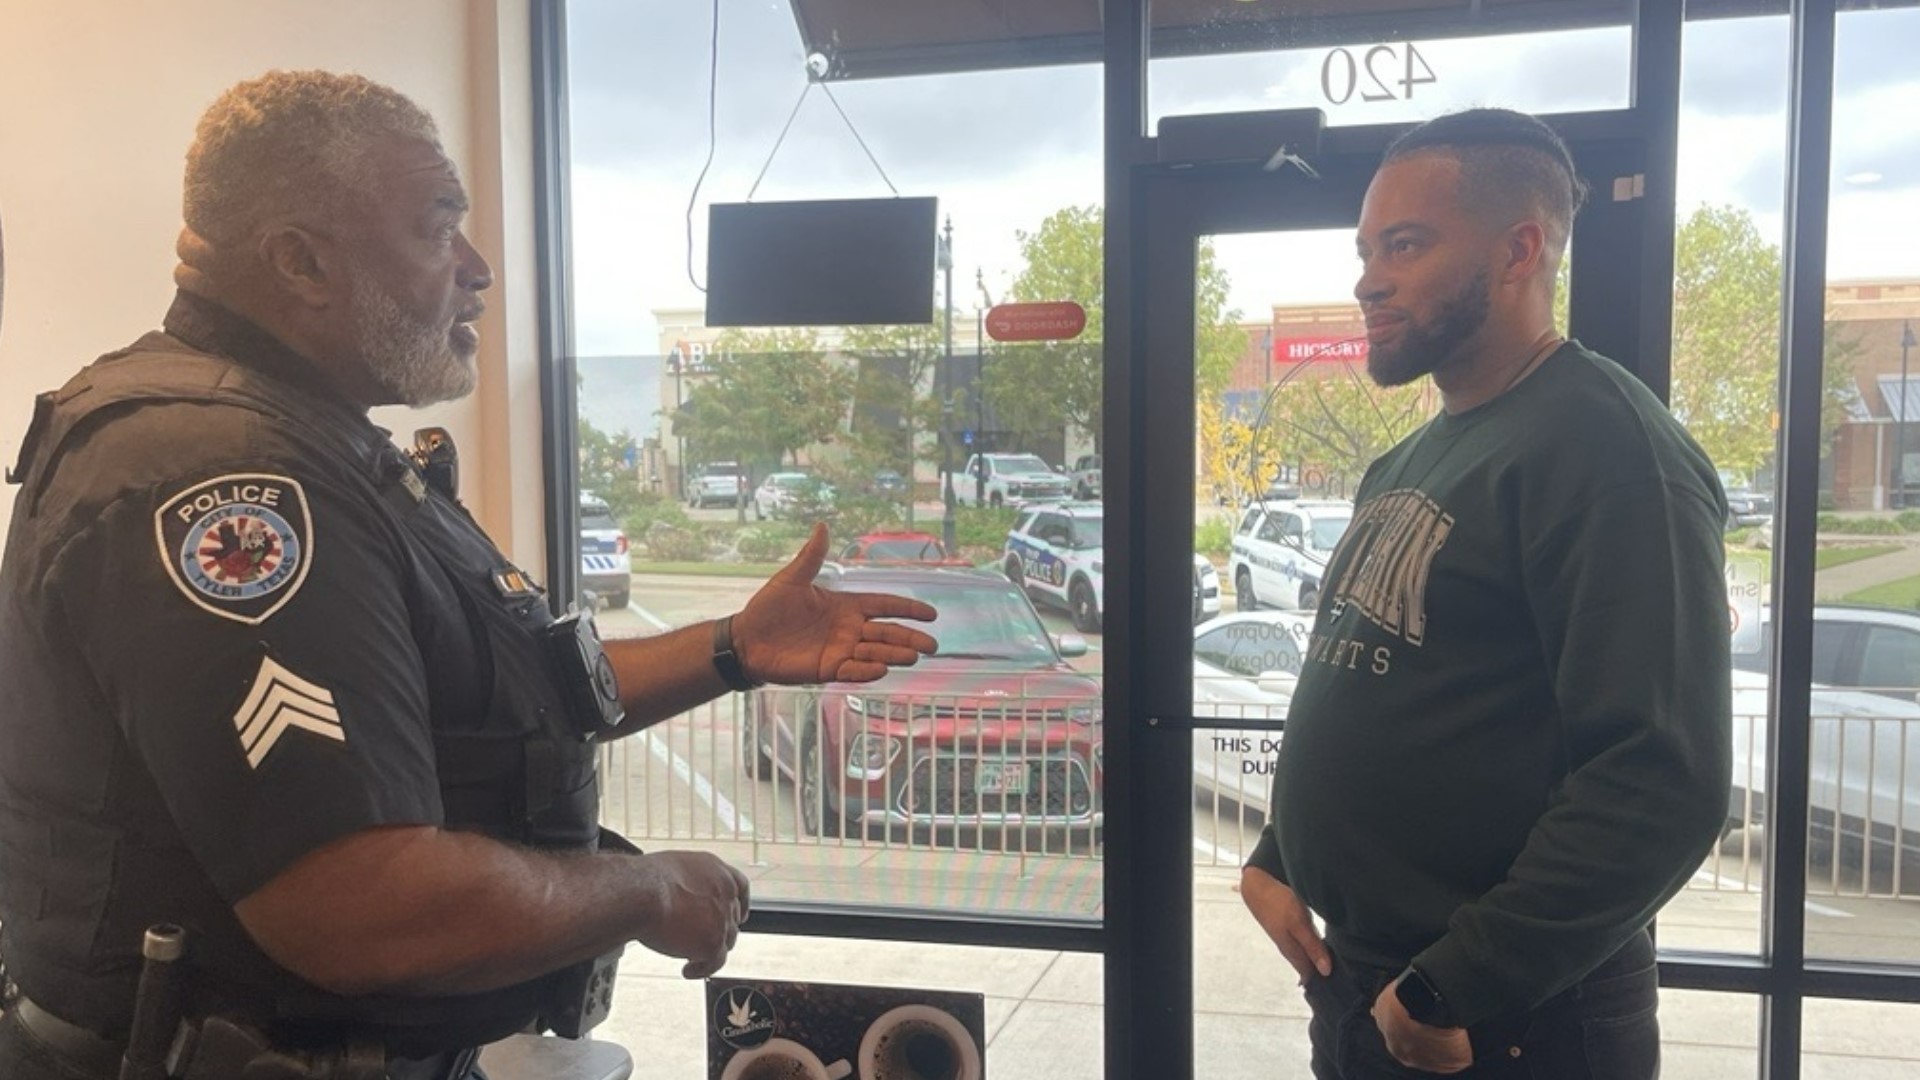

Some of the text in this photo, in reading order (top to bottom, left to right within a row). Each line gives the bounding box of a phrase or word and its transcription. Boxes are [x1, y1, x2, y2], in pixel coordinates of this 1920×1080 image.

[1288, 342, 1363, 358] HICKORY
[177, 485, 282, 523] POLICE
[201, 507, 266, 528] CITY OF
[194, 556, 296, 597] TYLER TEXAS
[1024, 559, 1052, 582] POLICE
[1211, 737, 1252, 753] THIS
